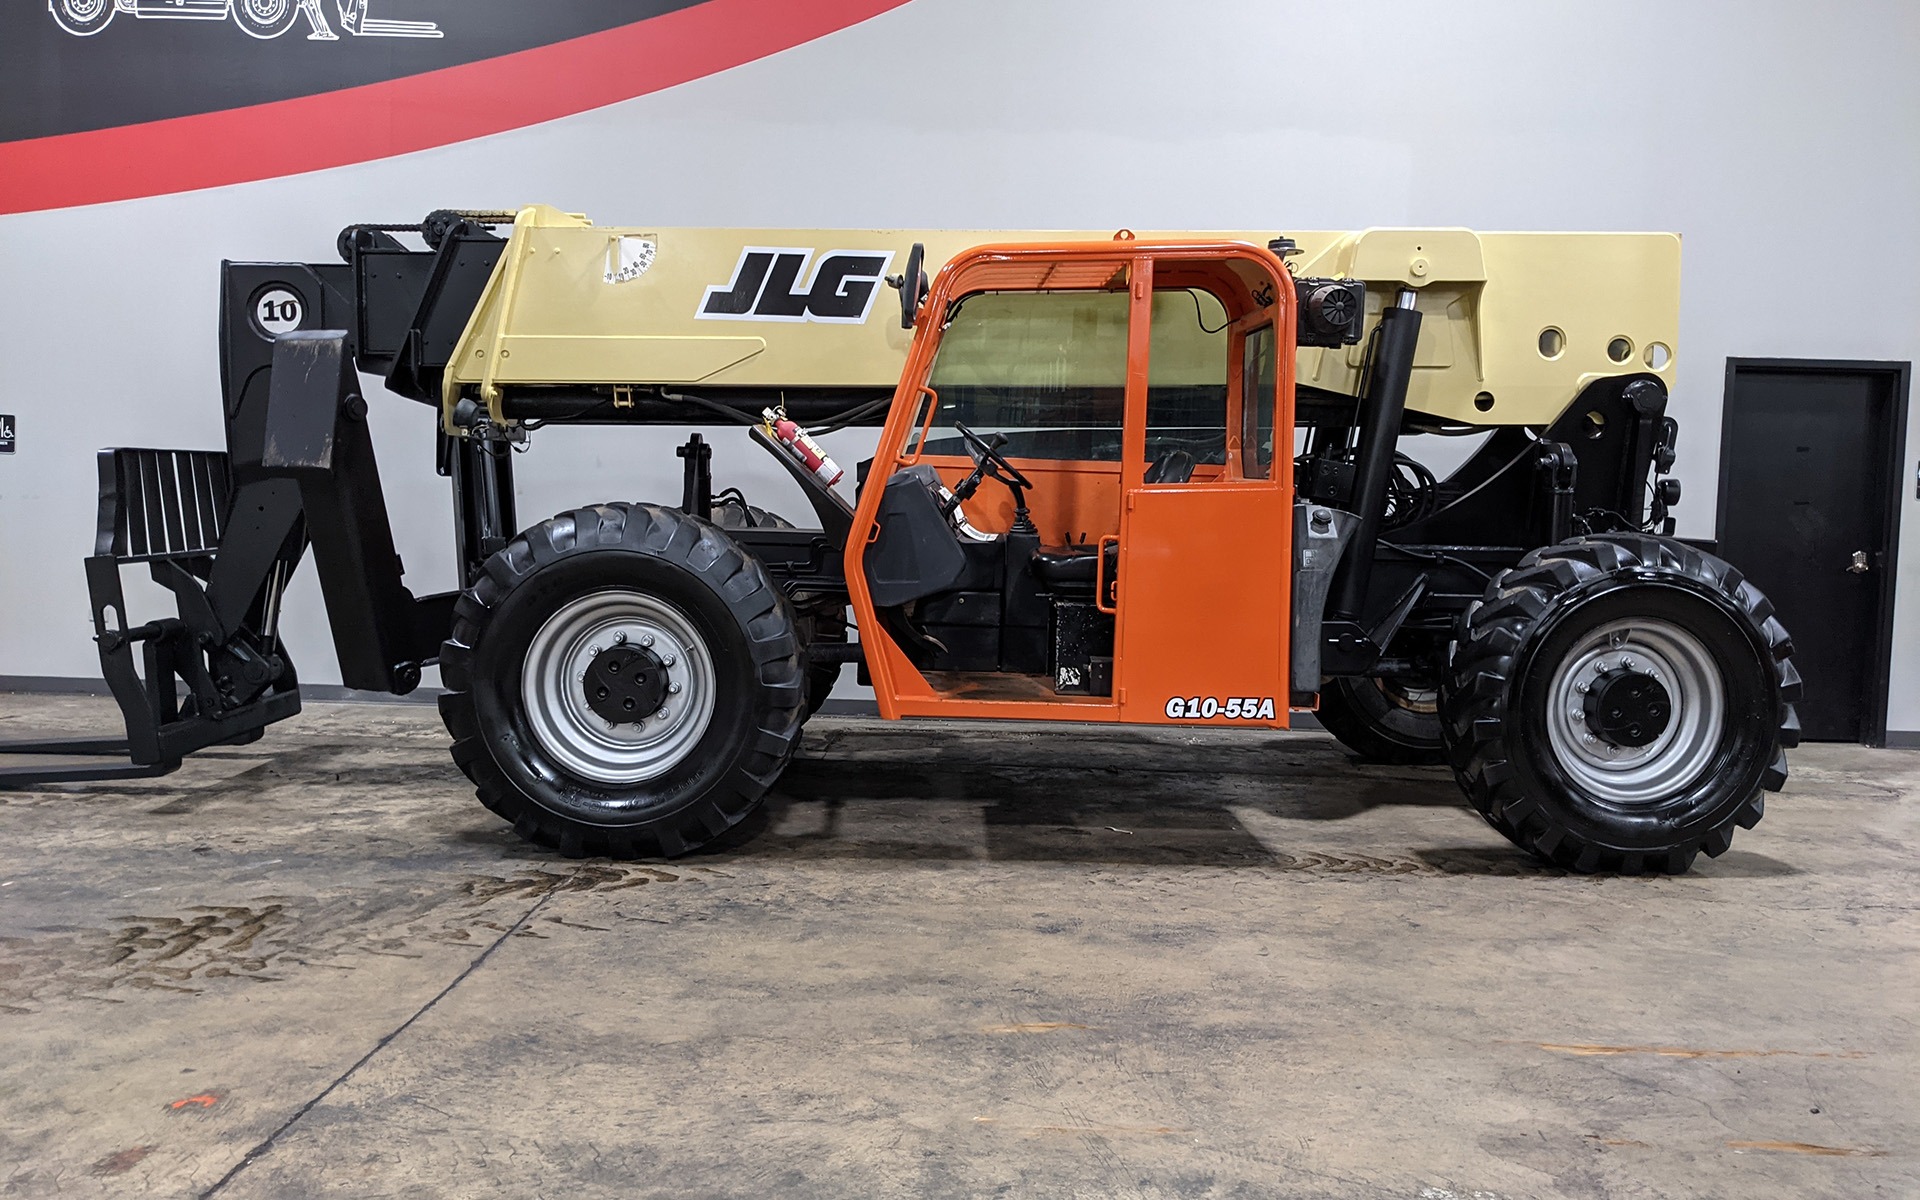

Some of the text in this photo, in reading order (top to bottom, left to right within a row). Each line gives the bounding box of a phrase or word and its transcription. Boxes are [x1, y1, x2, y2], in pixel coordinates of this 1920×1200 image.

[702, 252, 887, 319] JLG
[263, 300, 297, 322] 10
[1165, 697, 1276, 719] G10-55A
